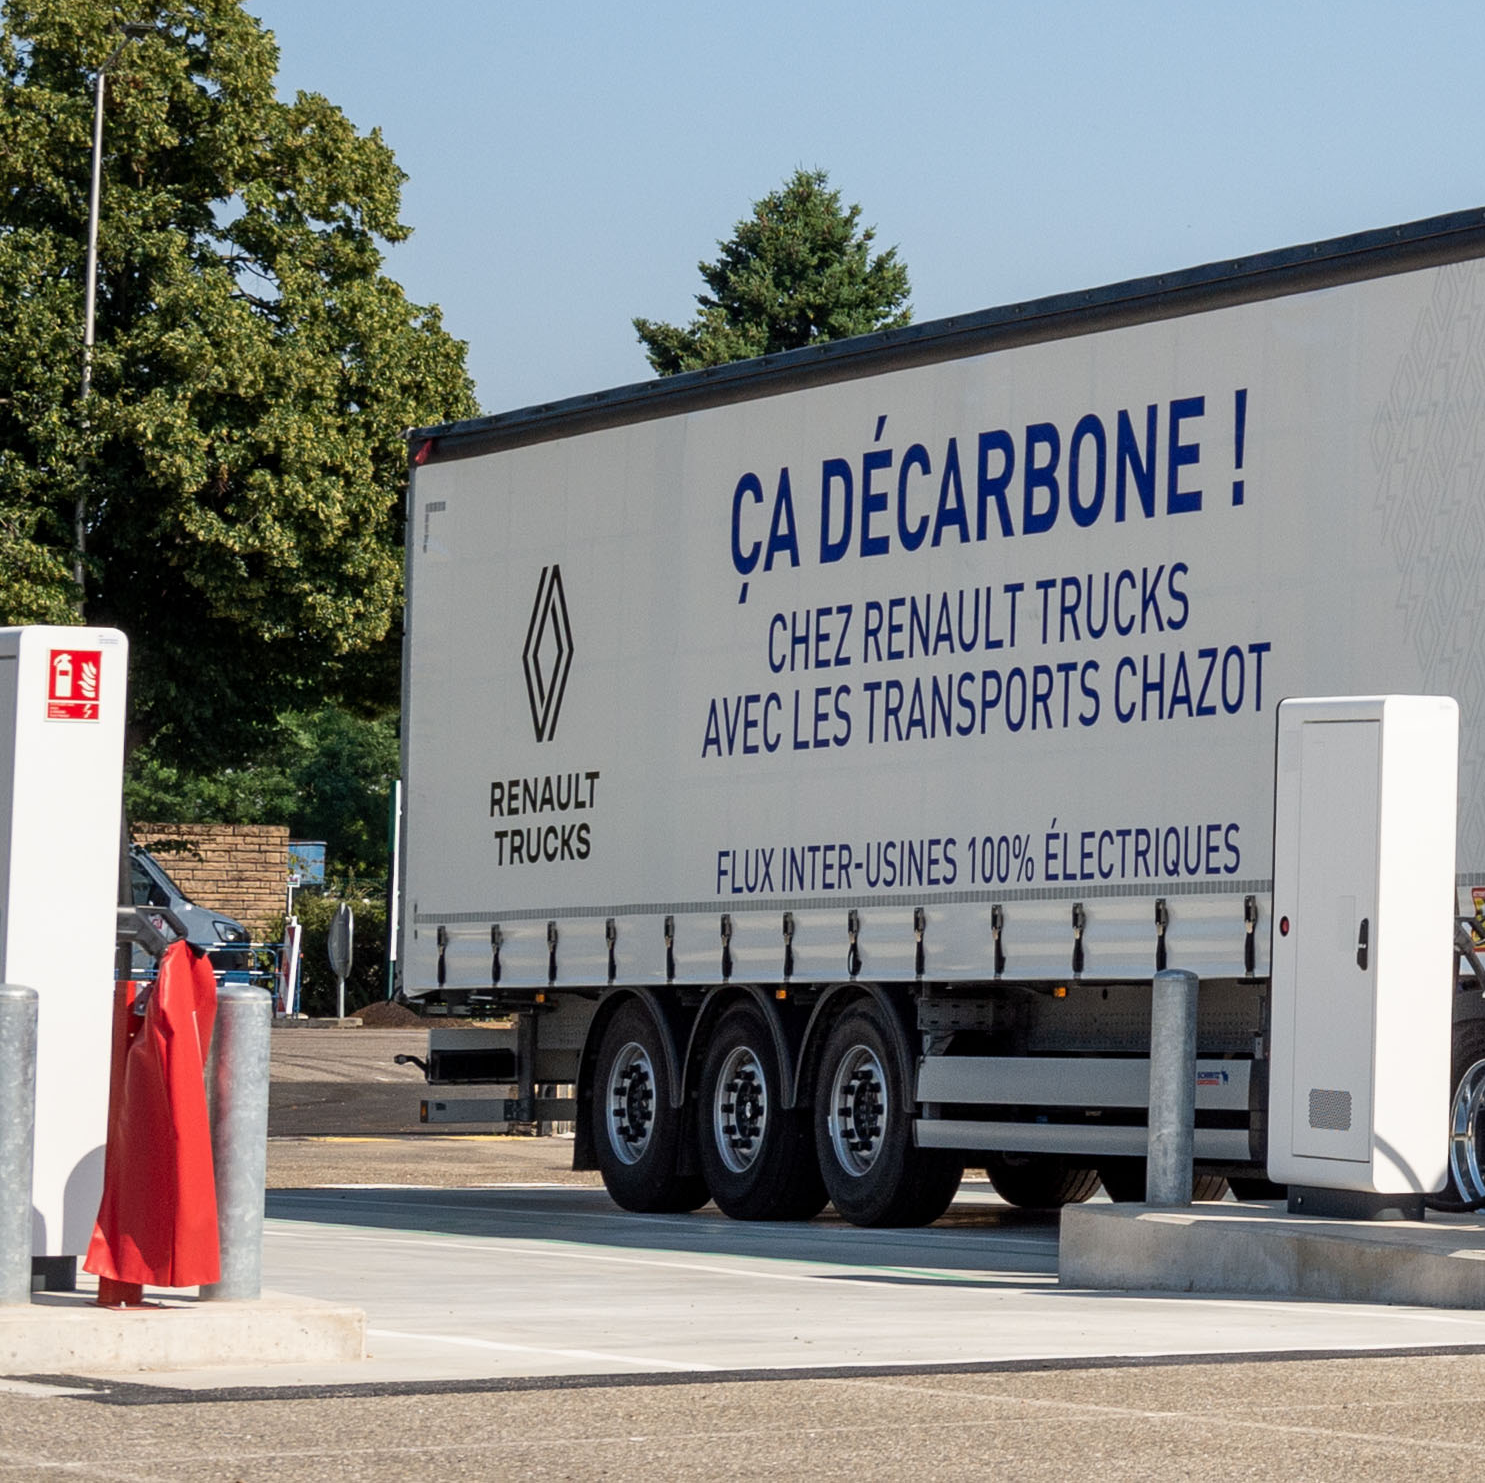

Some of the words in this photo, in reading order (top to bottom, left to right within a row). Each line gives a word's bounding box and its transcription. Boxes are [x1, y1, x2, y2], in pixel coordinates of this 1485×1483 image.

[731, 467, 801, 604] ÇA
[820, 395, 1205, 564] DÉCARBONE
[1232, 388, 1248, 506] !
[769, 604, 853, 673] CHEZ
[863, 583, 1024, 663] RENAULT
[1036, 562, 1189, 644] TRUCKS
[701, 689, 782, 758] AVEC
[793, 685, 851, 750] LES
[864, 660, 1100, 744] TRANSPORTS
[1114, 642, 1272, 723] CHAZOT
[490, 771, 600, 817] RENAULT
[494, 822, 591, 866] TRUCKS
[716, 847, 774, 894] FLUX
[782, 838, 957, 892] INTER-USINES
[967, 834, 1034, 883] 100%
[1045, 818, 1241, 881] ÉLECTRIQUES
